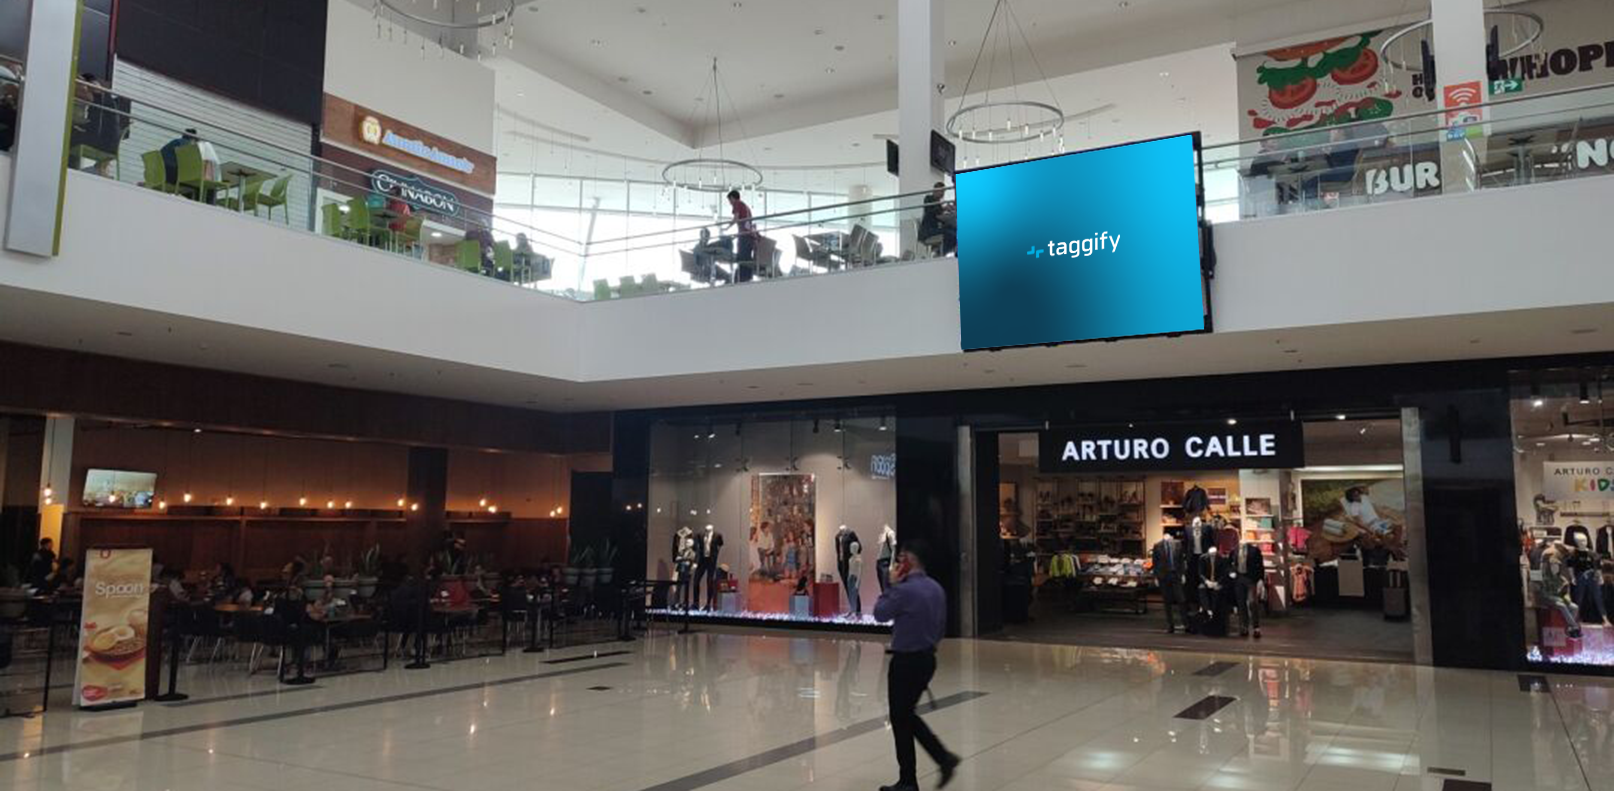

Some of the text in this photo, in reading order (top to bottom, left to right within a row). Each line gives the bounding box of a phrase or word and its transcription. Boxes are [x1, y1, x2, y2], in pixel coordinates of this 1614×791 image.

[1576, 138, 1614, 169] N
[1047, 231, 1121, 258] taggify
[1061, 434, 1276, 461] ARTURO CALLE
[1554, 467, 1600, 476] ARTURO
[95, 581, 145, 599] Spoon
